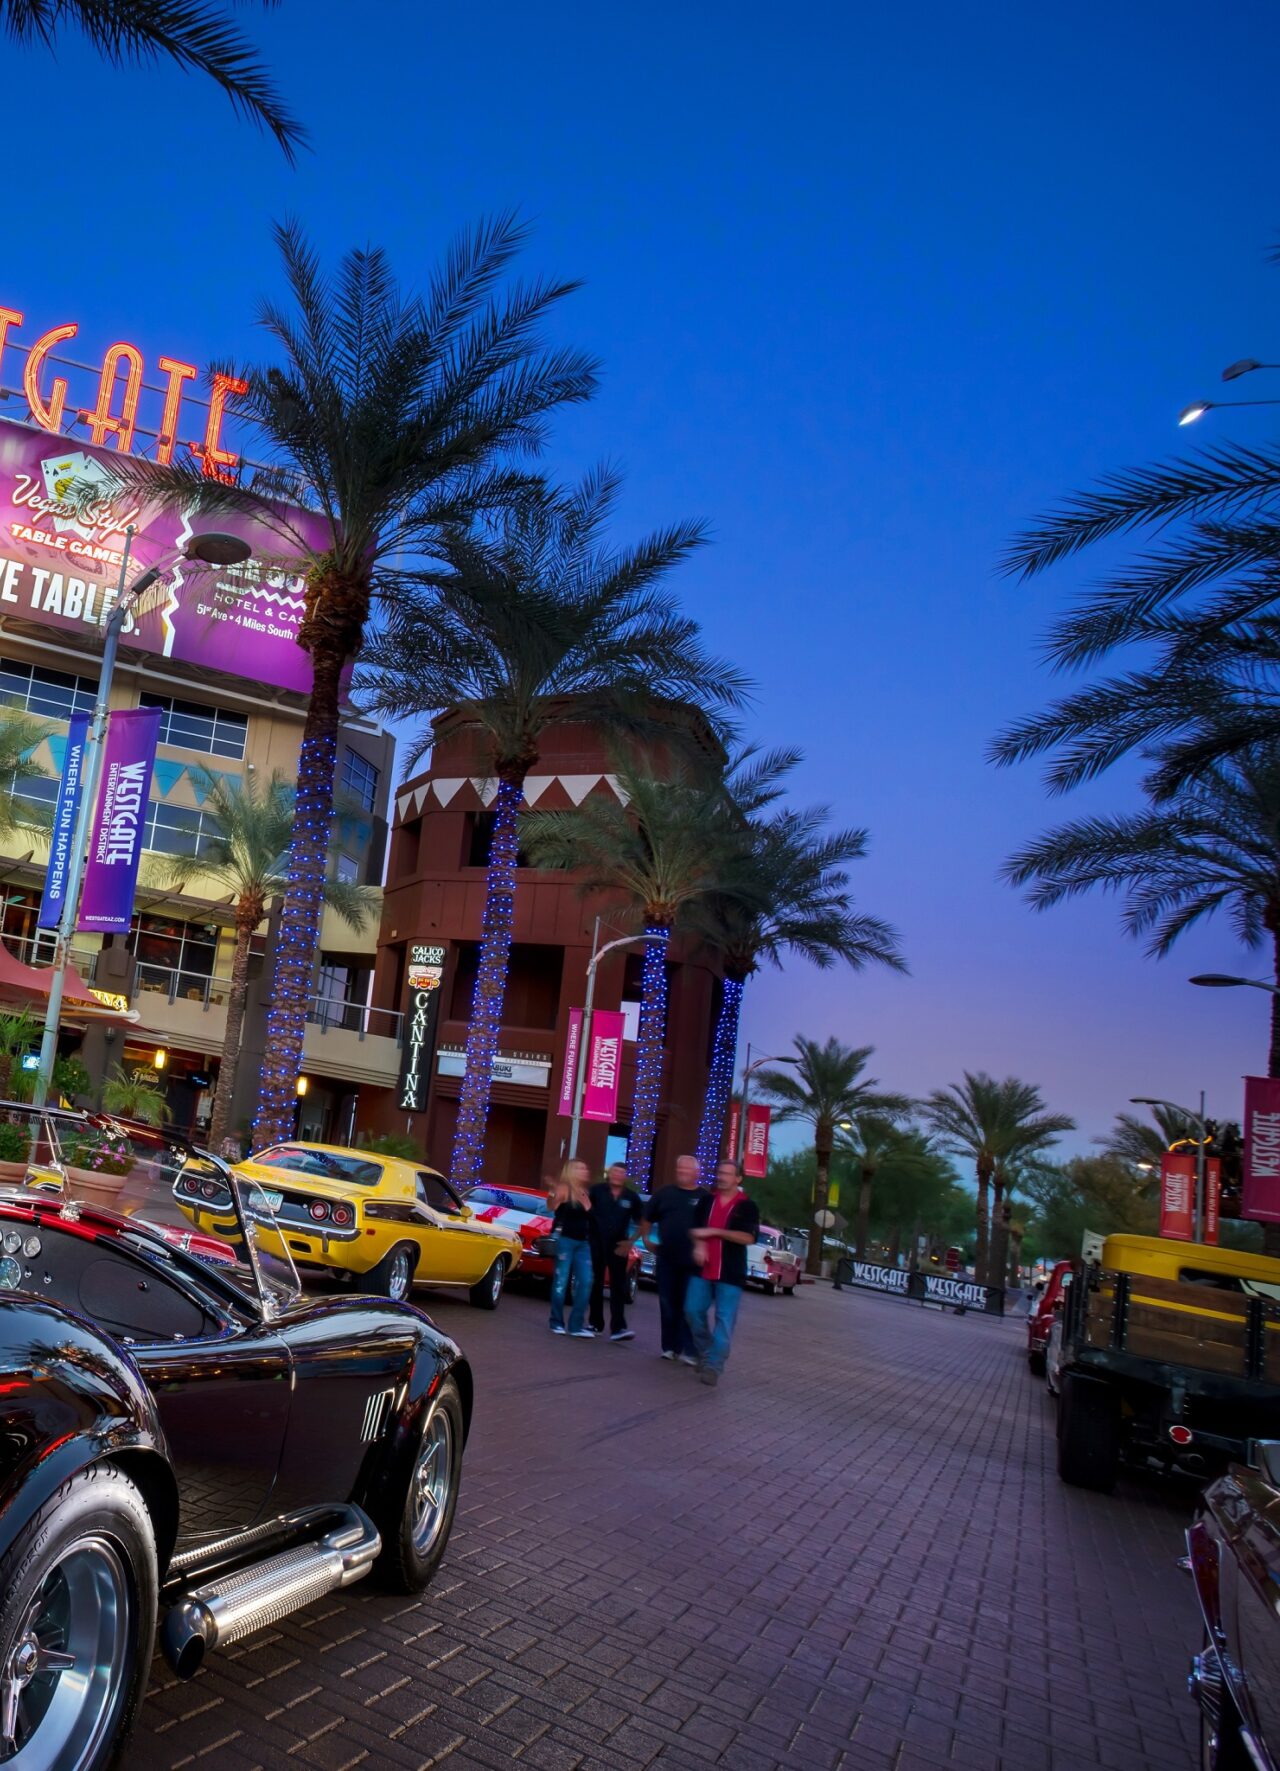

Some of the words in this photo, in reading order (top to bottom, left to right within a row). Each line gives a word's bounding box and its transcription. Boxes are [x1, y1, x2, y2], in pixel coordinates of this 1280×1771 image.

[11, 474, 77, 523] Vegas
[11, 523, 68, 550] TABLE
[211, 608, 228, 620] Ave
[235, 615, 241, 625] 4
[242, 616, 267, 632] Miles
[267, 623, 294, 640] South
[214, 592, 260, 613] HOTEL
[265, 607, 274, 617] &
[278, 611, 306, 625] CAS
[66, 744, 81, 796] WHERE
[101, 762, 119, 825] ENTERTAINMENT
[59, 799, 74, 829] FUN
[105, 760, 147, 866] WESTGATE
[95, 829, 109, 864] DISTRICT
[49, 832, 69, 900] HAPPENS
[412, 946, 444, 956] CALICO
[413, 954, 441, 964] JACKS
[402, 991, 430, 1108] CANTINA
[568, 1023, 578, 1049] WHERE
[596, 1037, 619, 1090] WESTGATE
[563, 1067, 574, 1101] HAPPENS
[1251, 1111, 1280, 1177] WESTGATE
[852, 1261, 911, 1288] WESTGATE
[925, 1275, 988, 1303] WESTGATE
